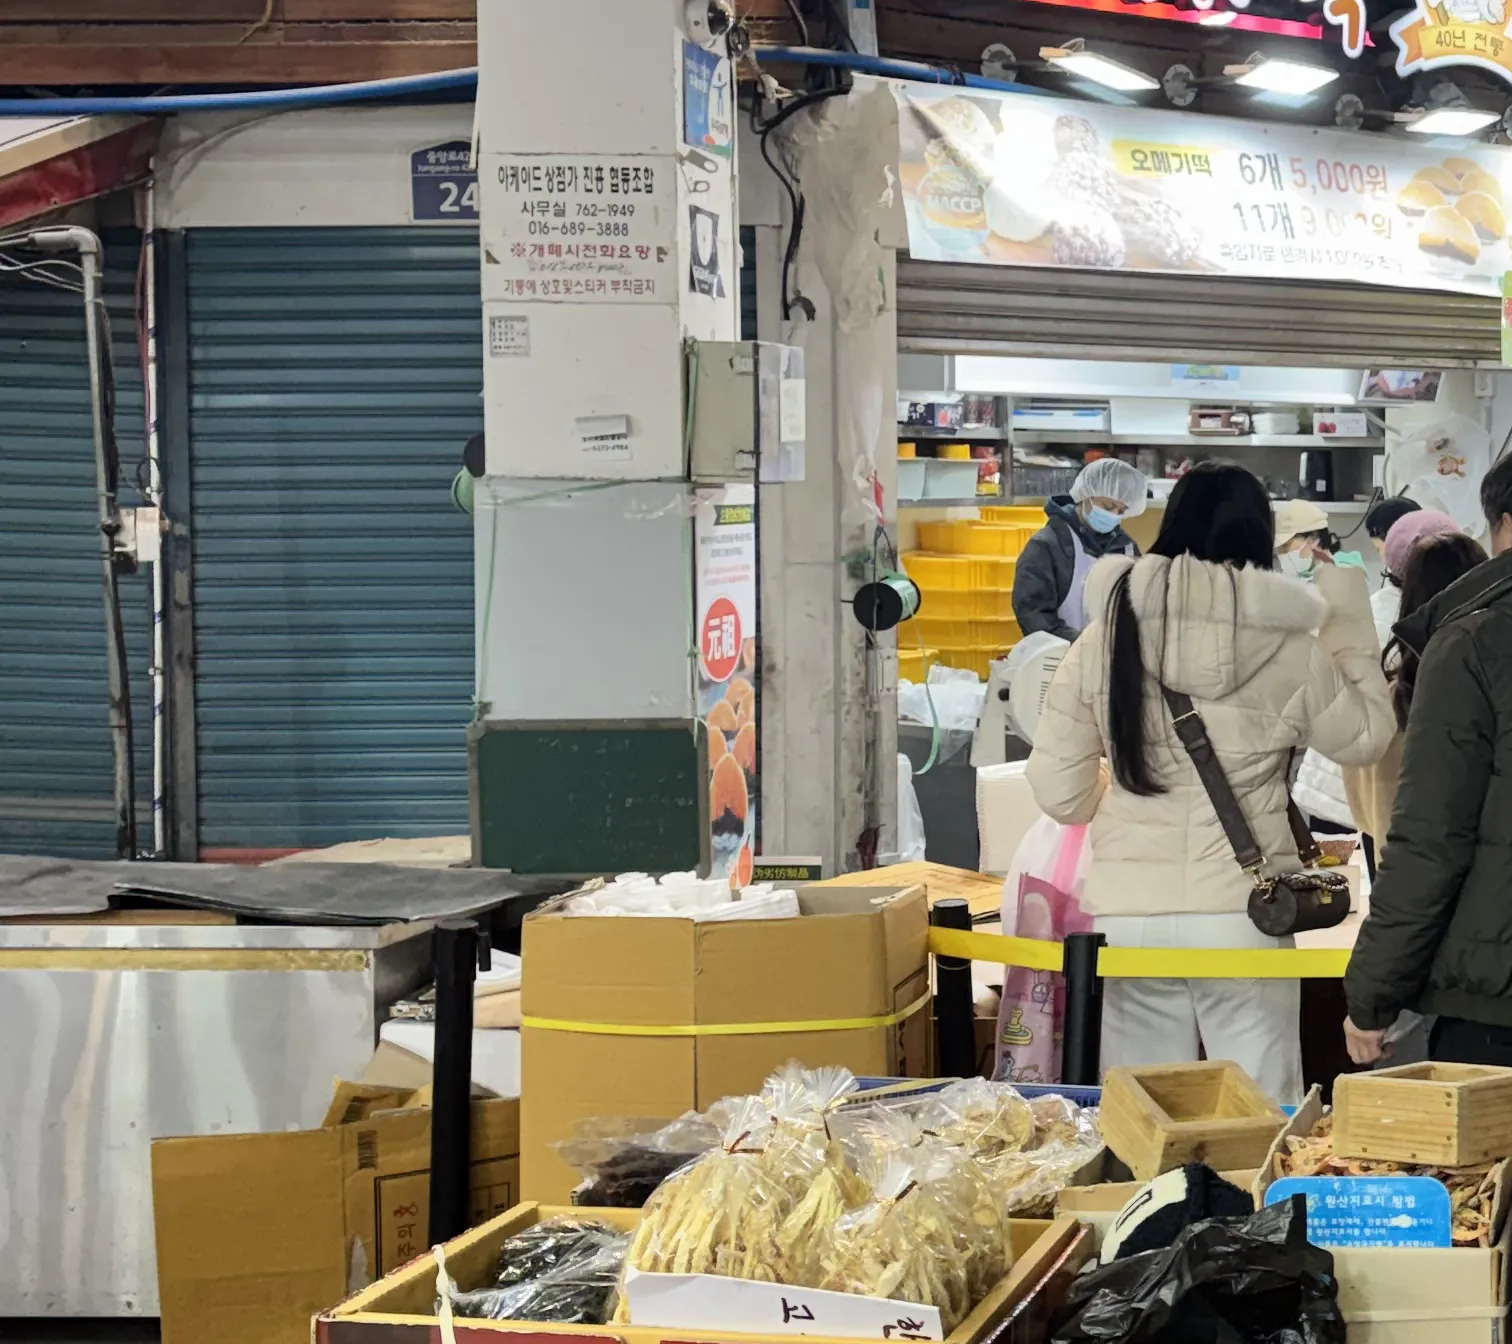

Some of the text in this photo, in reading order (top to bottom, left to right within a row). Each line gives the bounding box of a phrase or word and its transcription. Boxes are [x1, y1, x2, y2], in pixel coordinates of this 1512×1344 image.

[1435, 29, 1468, 49] 40년
[498, 166, 543, 193] 아케이드
[545, 166, 578, 194] 상점가
[610, 167, 654, 194] 협동조합
[1129, 149, 1388, 201] 오메기떡 6개 5,000원
[438, 181, 480, 213] 24
[926, 196, 981, 214] HACCP
[521, 201, 635, 217] 사무실 762-1949
[528, 221, 629, 237] 016-689-3888
[611, 279, 655, 295] 부착금지
[708, 613, 735, 662] 元祖
